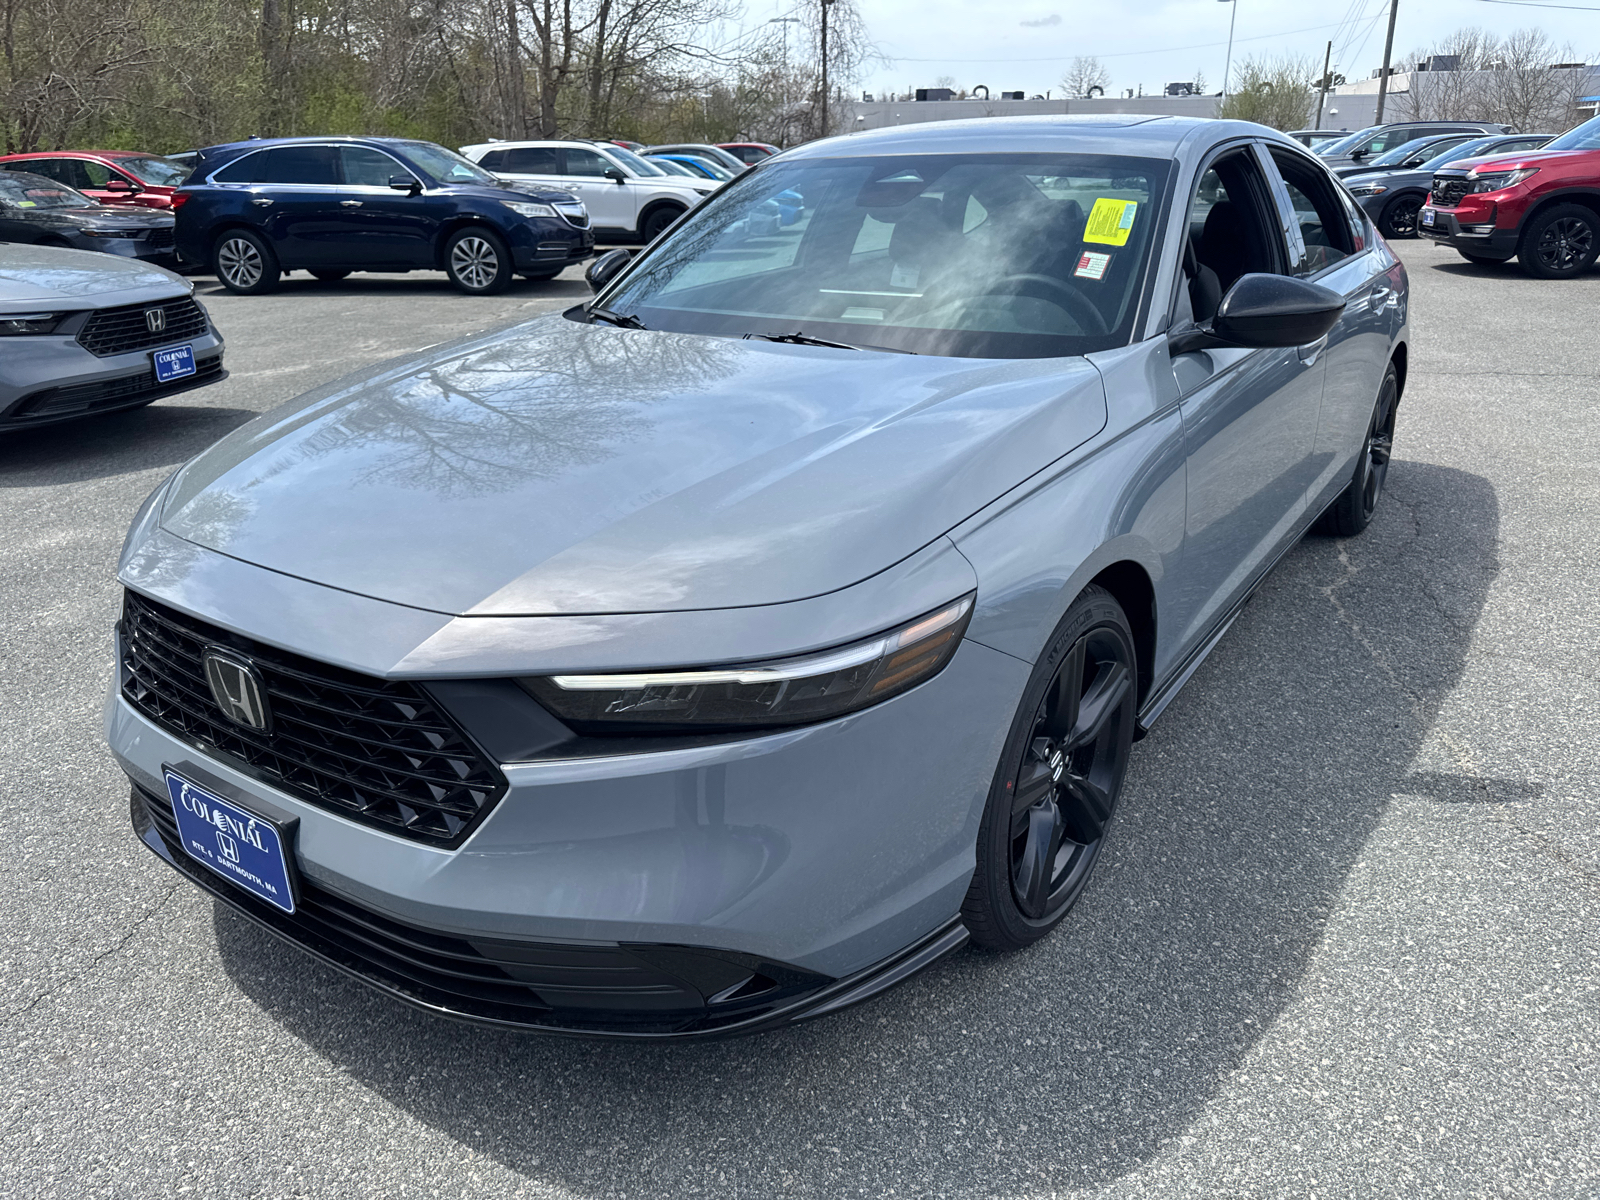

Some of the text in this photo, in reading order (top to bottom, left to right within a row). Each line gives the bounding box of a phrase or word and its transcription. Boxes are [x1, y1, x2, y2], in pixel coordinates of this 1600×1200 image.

[1055, 613, 1087, 652] MICHELIN
[180, 787, 269, 853] COLONIAL
[191, 840, 278, 895] RTE. 6 DARTMOUTH, MA
